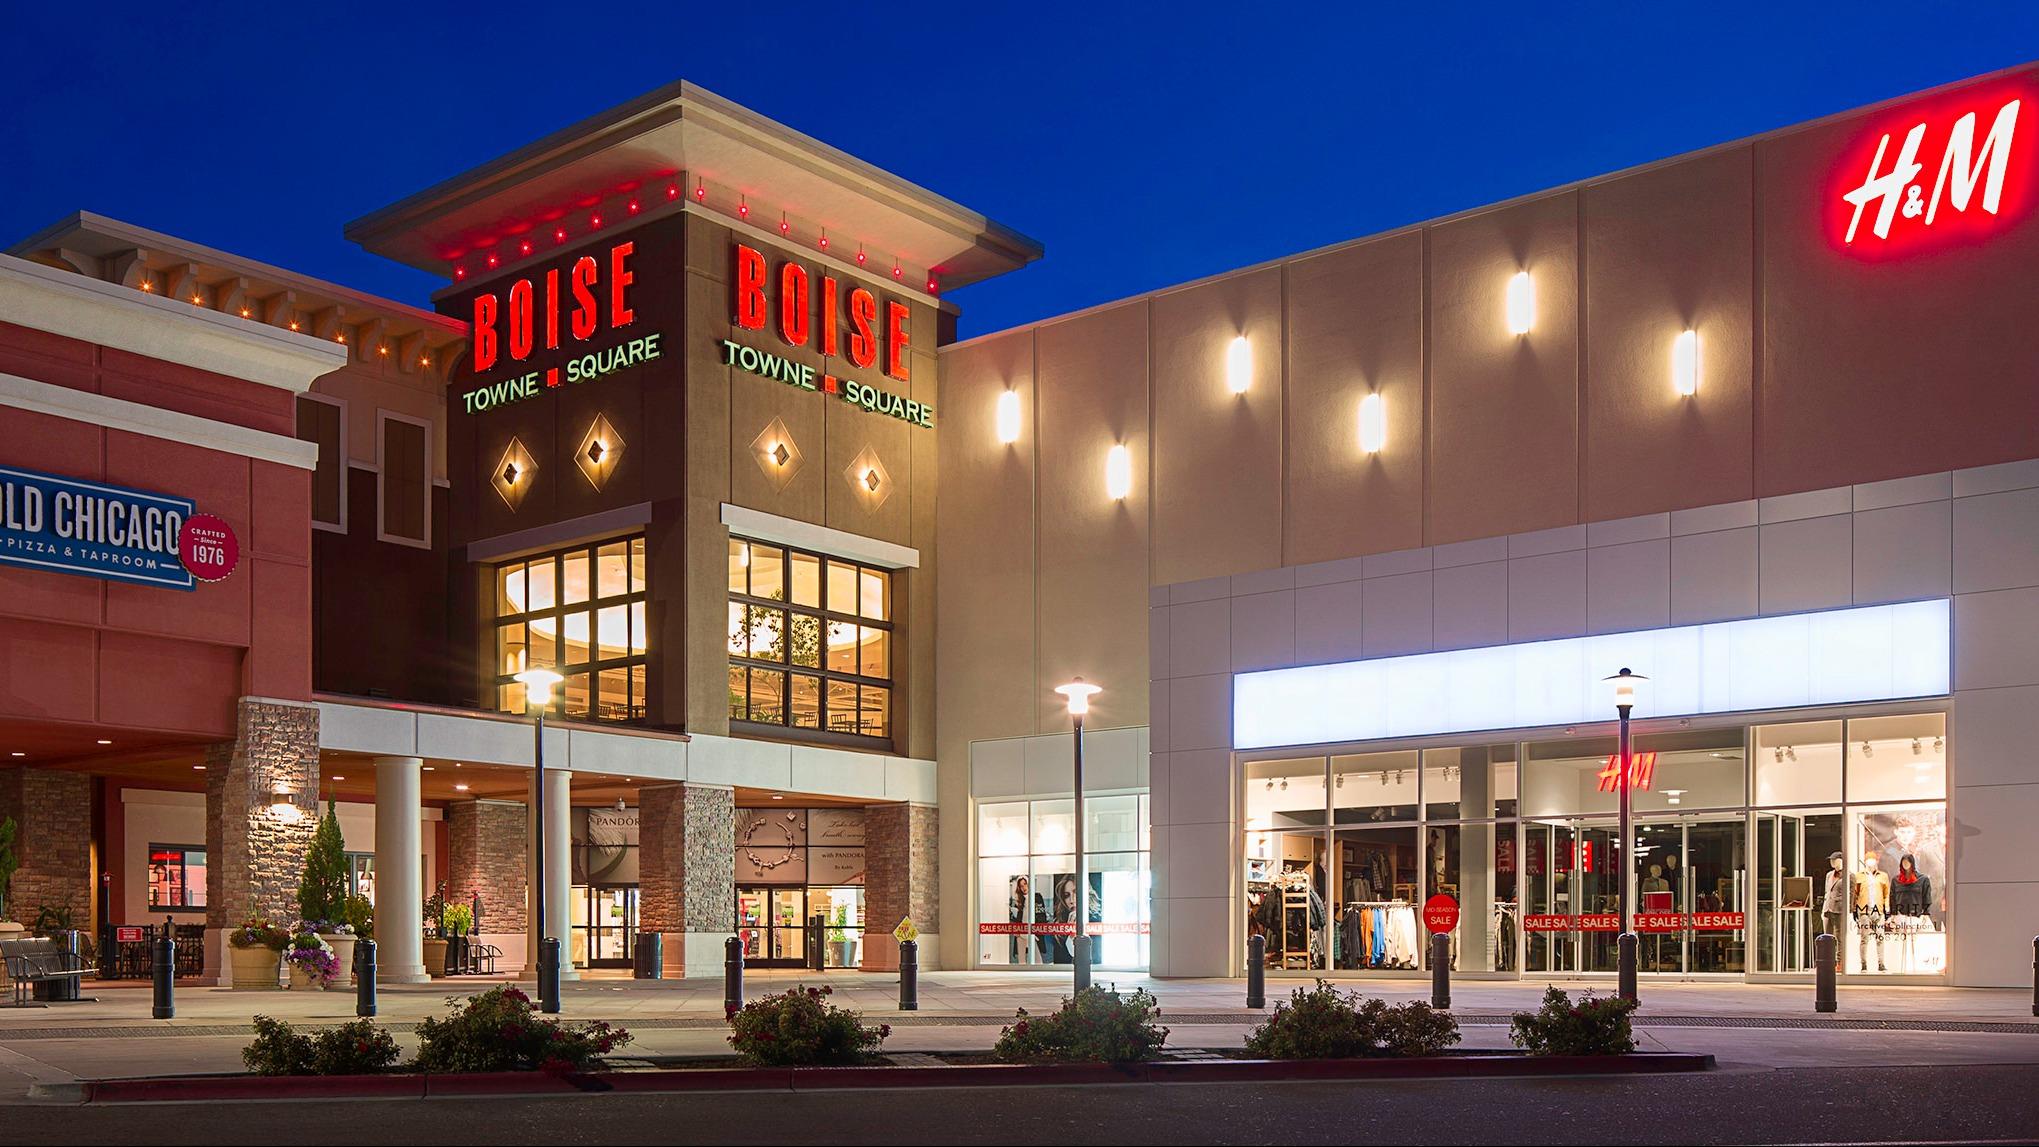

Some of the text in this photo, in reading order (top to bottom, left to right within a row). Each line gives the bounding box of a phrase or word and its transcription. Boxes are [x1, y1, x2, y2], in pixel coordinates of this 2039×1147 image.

[1843, 99, 2020, 242] H&M
[474, 241, 634, 373] BOISE
[737, 243, 910, 381] BOISE
[463, 333, 660, 413] TOWNE SQUARE
[724, 339, 934, 428] TOWNE SQUARE
[0, 482, 182, 556] LD CHICAGO
[191, 527, 226, 539] CRAFTED
[7, 538, 157, 569] PIZZA & TAPROOM
[193, 544, 224, 566] 1976
[200, 537, 217, 545] Since
[1597, 752, 1656, 792] HM
[1497, 839, 1511, 873] SALE
[1032, 925, 1047, 933] SALE
[1048, 925, 1064, 933] SALE
[1430, 916, 1451, 925] SALE
[1525, 918, 1551, 928] SALE
[1582, 918, 1610, 928] SALE
[1649, 917, 1678, 927] SALE
[1713, 915, 1742, 926] SALE
